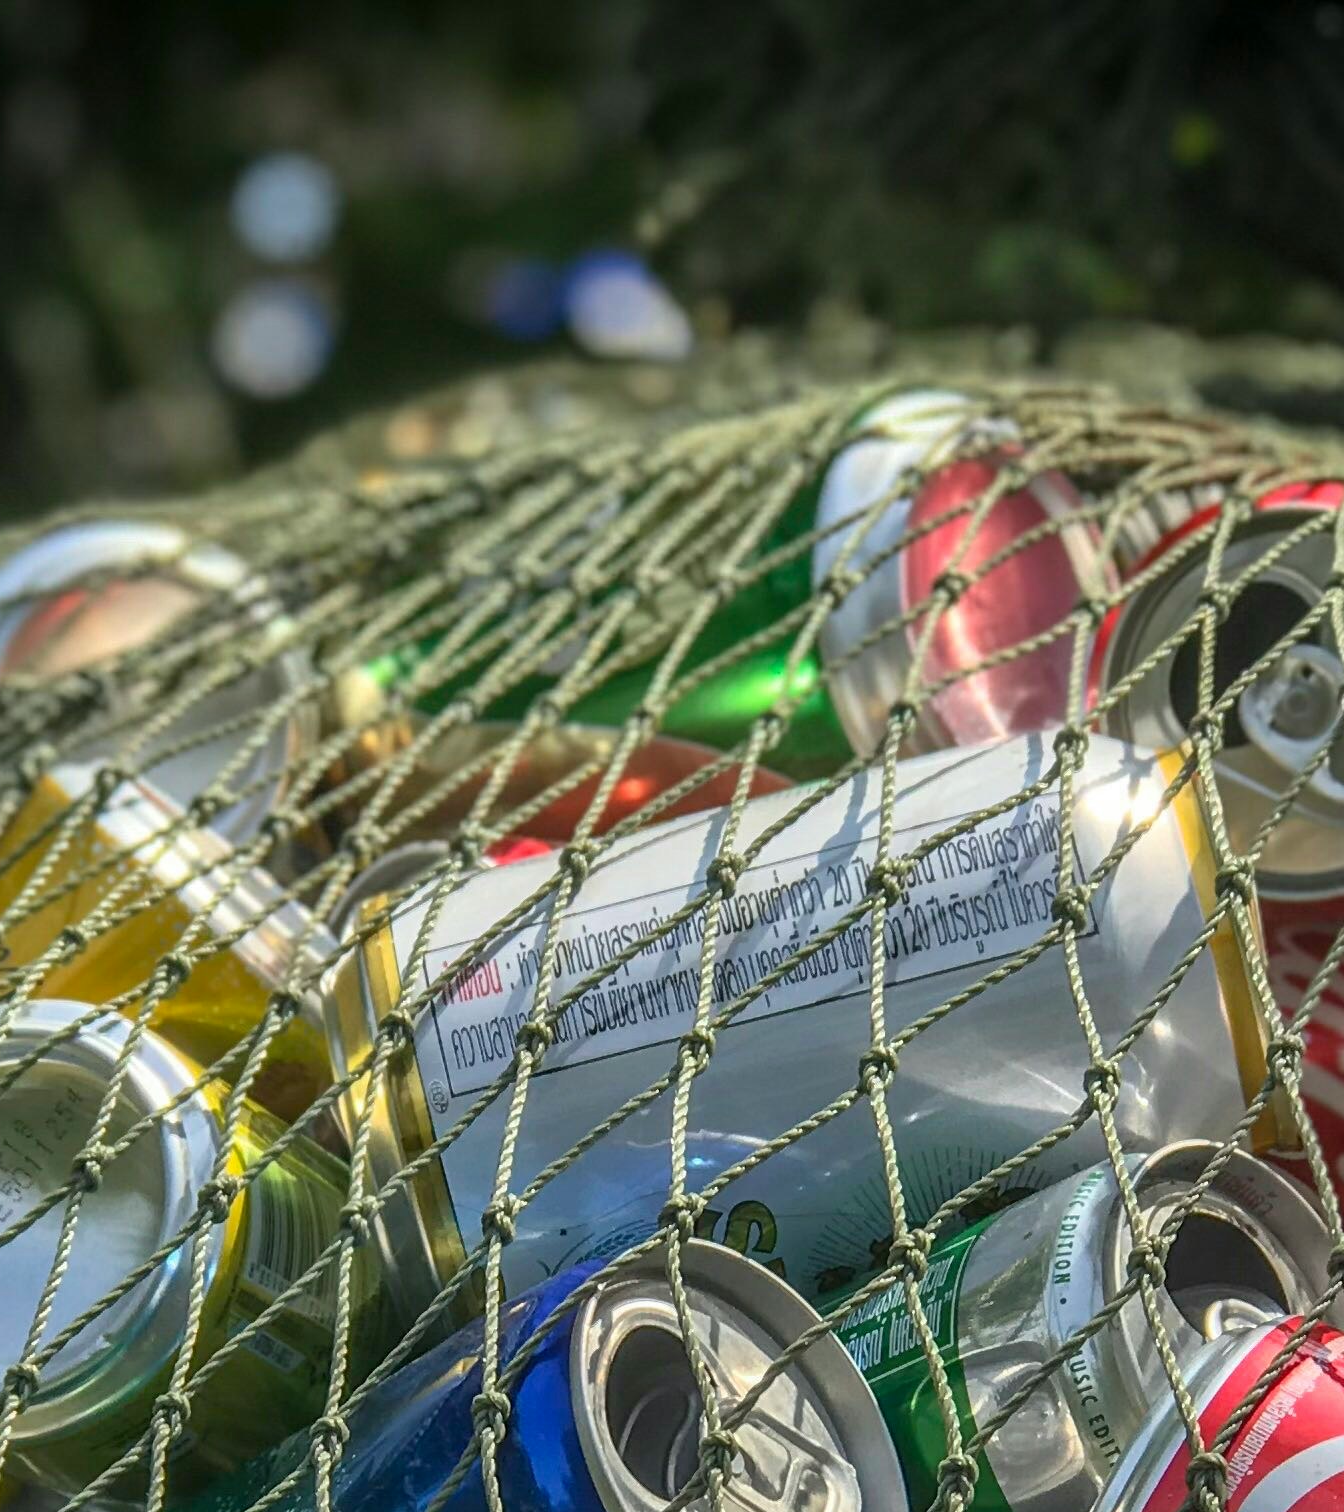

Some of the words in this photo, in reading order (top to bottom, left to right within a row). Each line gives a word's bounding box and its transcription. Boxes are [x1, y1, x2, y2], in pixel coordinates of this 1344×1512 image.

[433, 950, 504, 1008] คำเตอน
[825, 862, 854, 907] 20
[932, 800, 1067, 885] การดมสุราทำให้
[902, 902, 933, 953] 20
[1054, 1212, 1081, 1286] EDITION
[1087, 1413, 1120, 1469] EDIT
